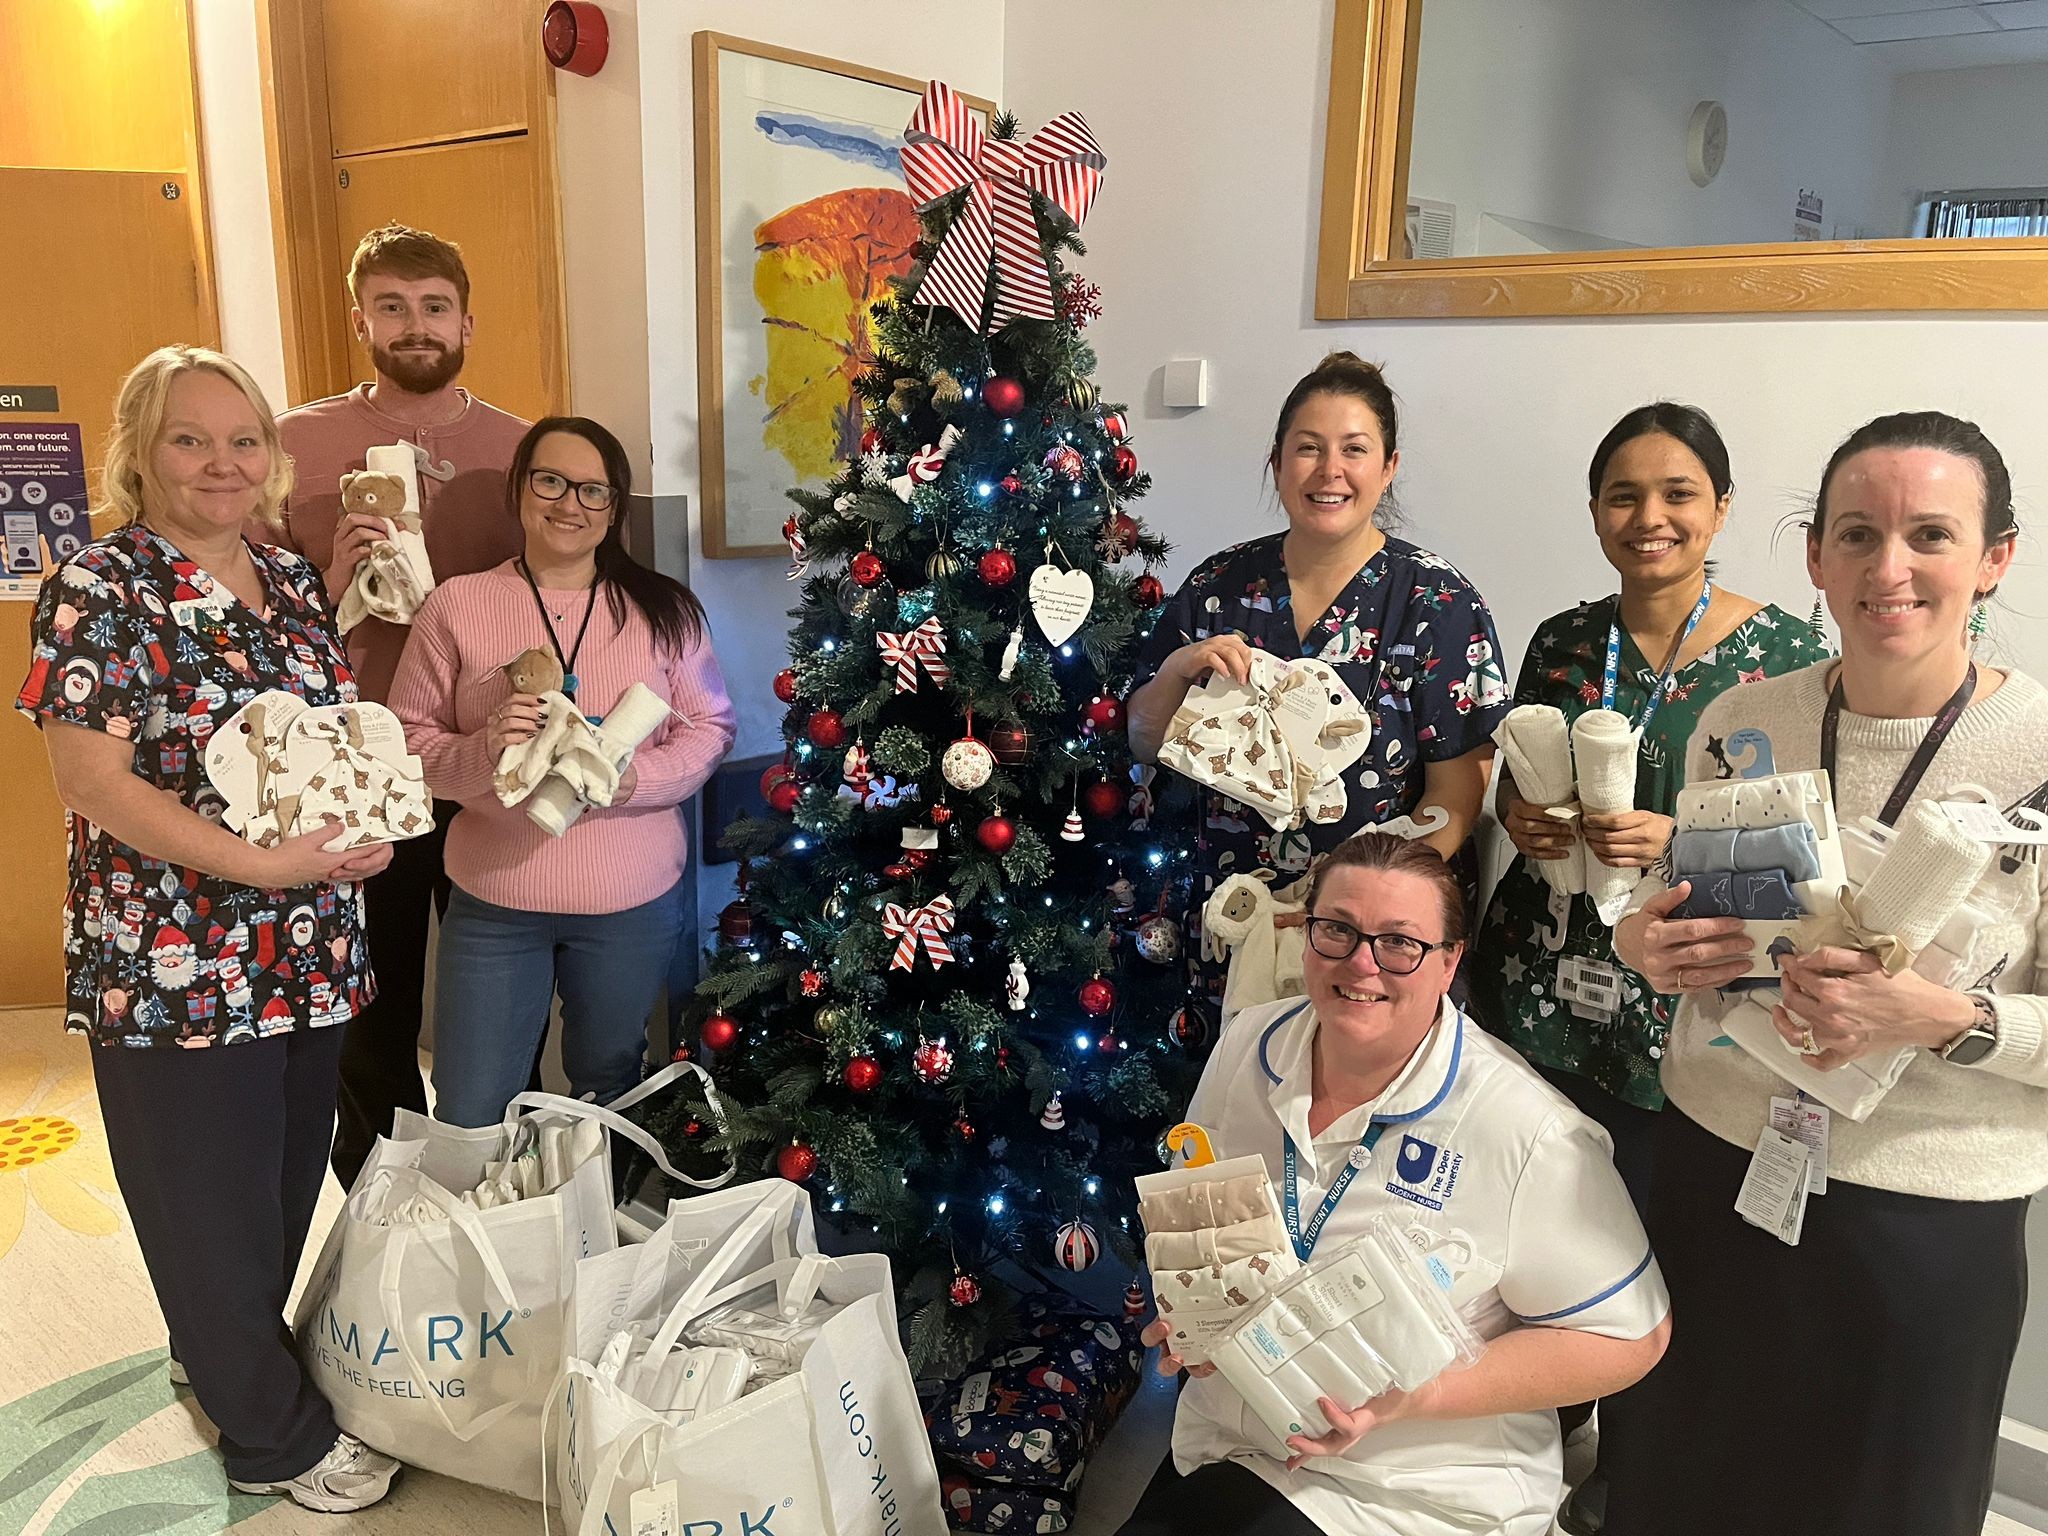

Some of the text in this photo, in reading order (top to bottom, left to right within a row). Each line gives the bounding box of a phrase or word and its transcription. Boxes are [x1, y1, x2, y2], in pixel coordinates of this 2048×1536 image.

[35, 431, 70, 440] record.
[16, 444, 36, 452] one
[37, 442, 71, 452] future.
[1691, 602, 1705, 624] NHS
[1609, 624, 1619, 645] NHS
[1606, 651, 1617, 671] NHS
[1604, 677, 1615, 697] NHS
[1652, 681, 1665, 700] NHS
[1285, 1152, 1296, 1199] STUDENT
[1430, 1149, 1451, 1193] The Open
[1443, 1153, 1464, 1198] University
[1386, 1183, 1442, 1210] STUDENT NURSE
[1303, 1169, 1352, 1250] STUDENT NURSE
[1327, 1287, 1343, 1308] Short
[333, 1356, 364, 1388] THE
[368, 1378, 465, 1399] FEELNG
